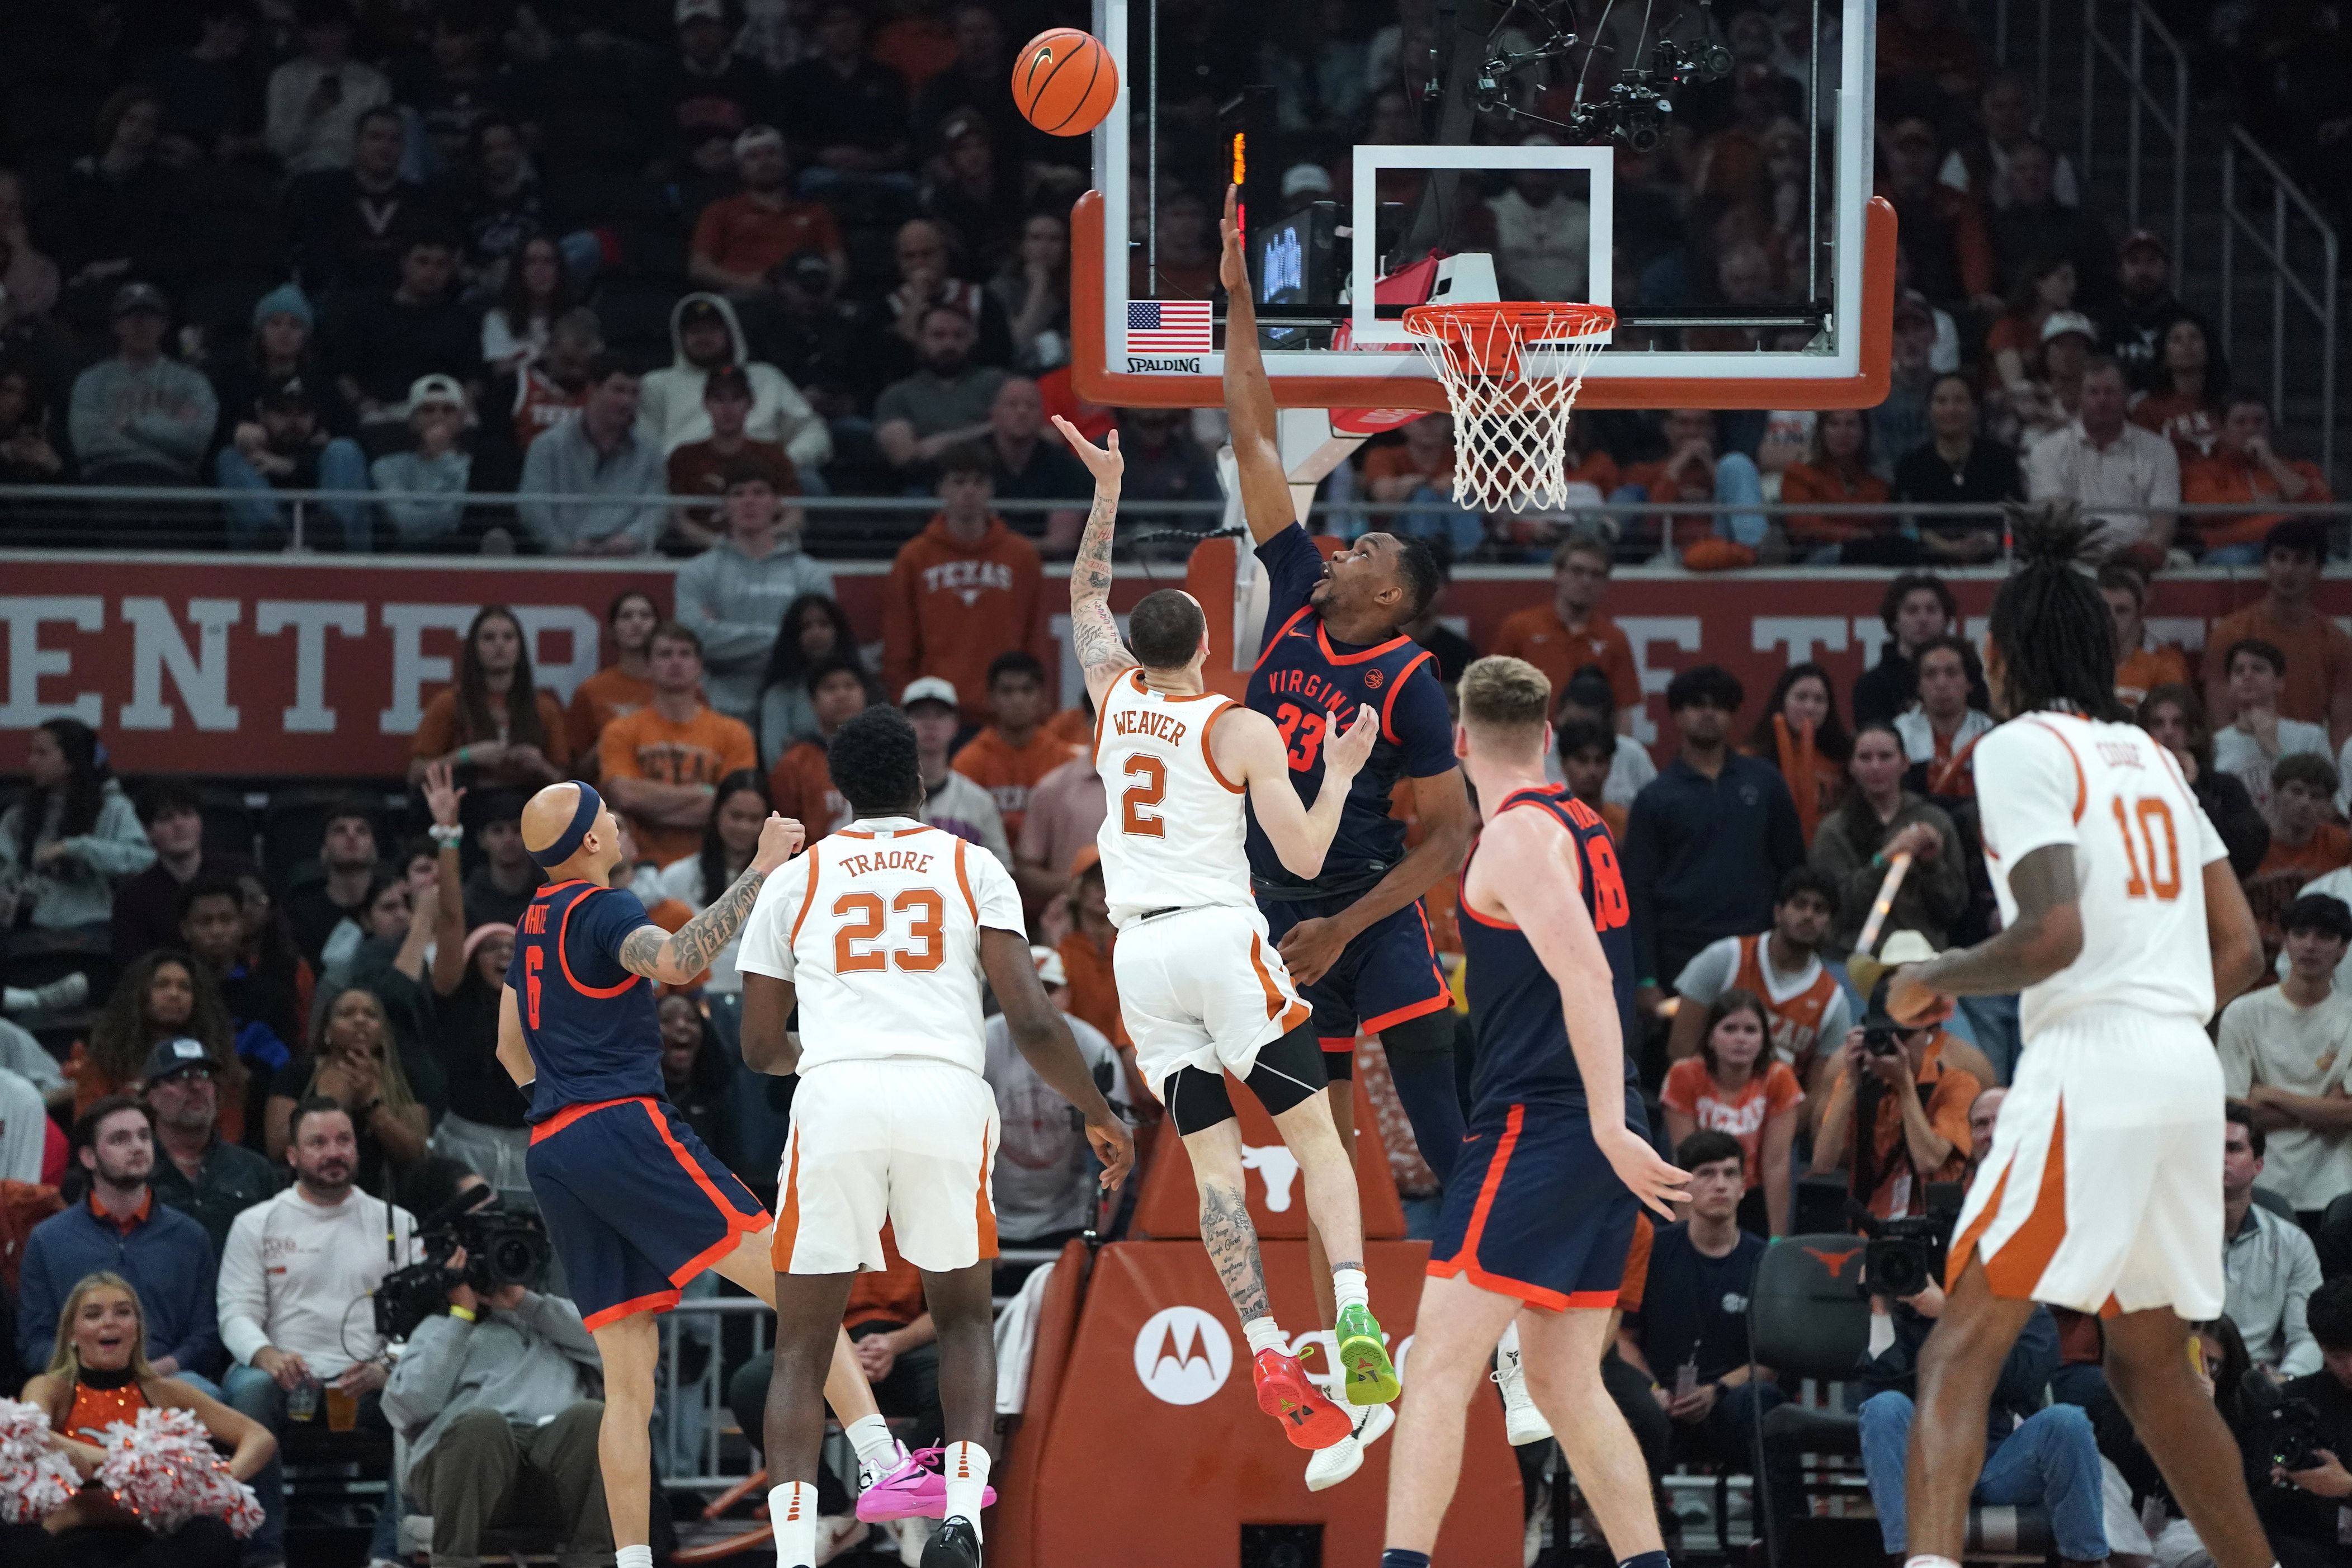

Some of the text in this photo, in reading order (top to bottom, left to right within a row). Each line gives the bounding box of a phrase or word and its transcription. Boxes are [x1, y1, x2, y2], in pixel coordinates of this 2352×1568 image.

[1127, 357, 1200, 374] SPALDING
[923, 560, 1013, 594] TEXAS
[1113, 710, 1187, 748] WEAVER
[1276, 702, 1326, 773] 33
[1121, 752, 1168, 839] 2
[838, 851, 935, 878] TRAORE
[2112, 795, 2181, 899] 10
[831, 887, 946, 976] 23
[525, 945, 545, 1031] 6
